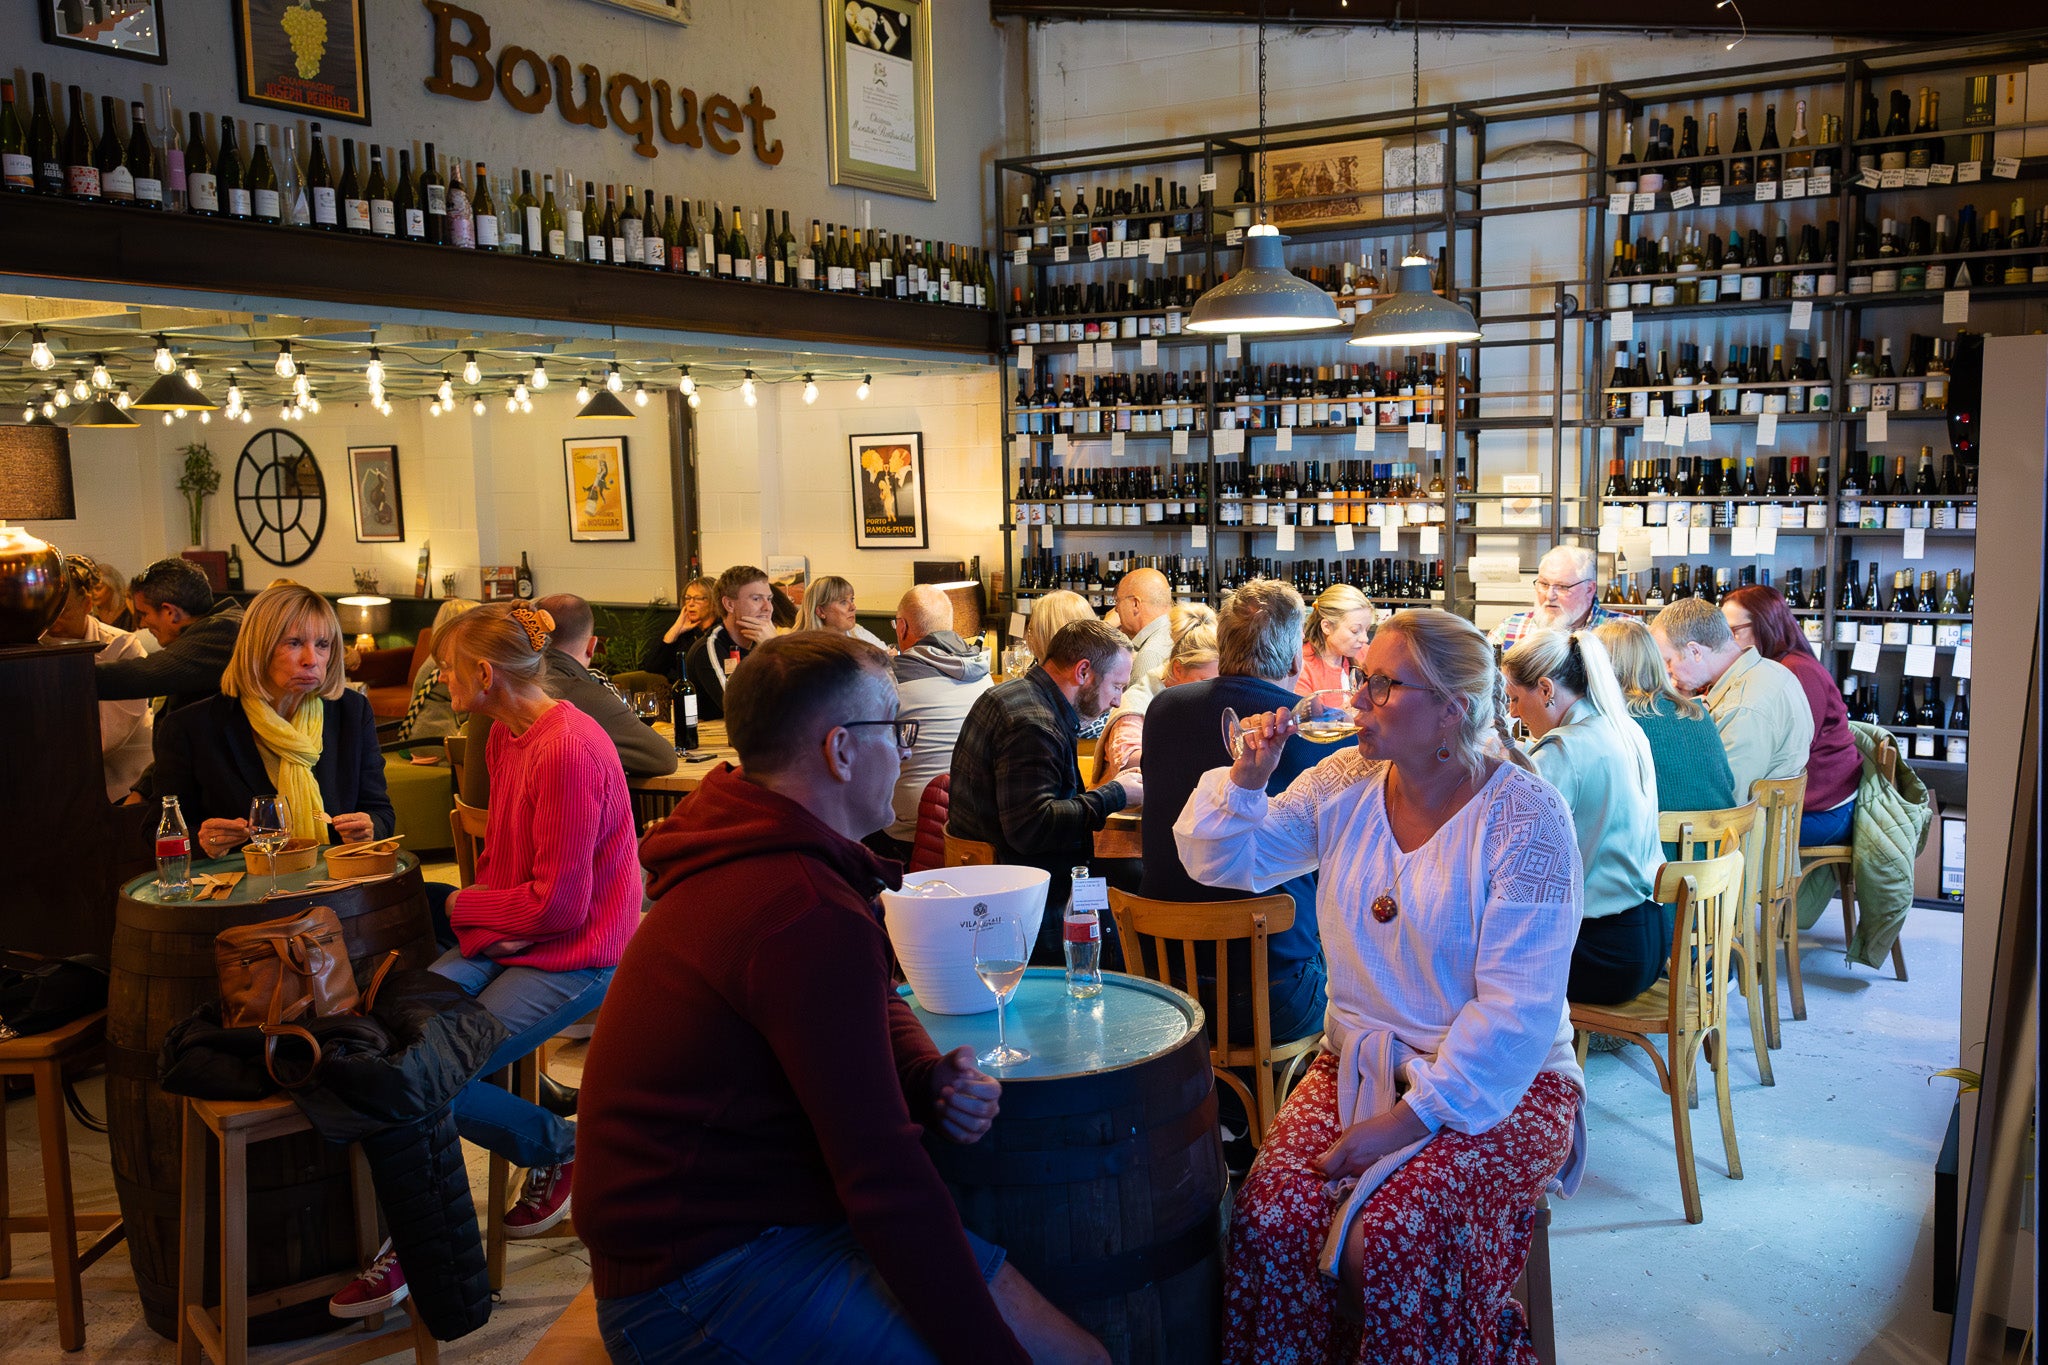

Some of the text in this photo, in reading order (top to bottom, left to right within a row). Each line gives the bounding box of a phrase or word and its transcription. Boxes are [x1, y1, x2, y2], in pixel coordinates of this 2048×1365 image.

[278, 75, 336, 93] CHAMPAGNE
[424, 0, 784, 166] Bouquet
[264, 82, 352, 111] JOSEPH PERRIER
[1966, 115, 1992, 123] DEUTZ
[866, 526, 914, 534] RAMOS-PINTO
